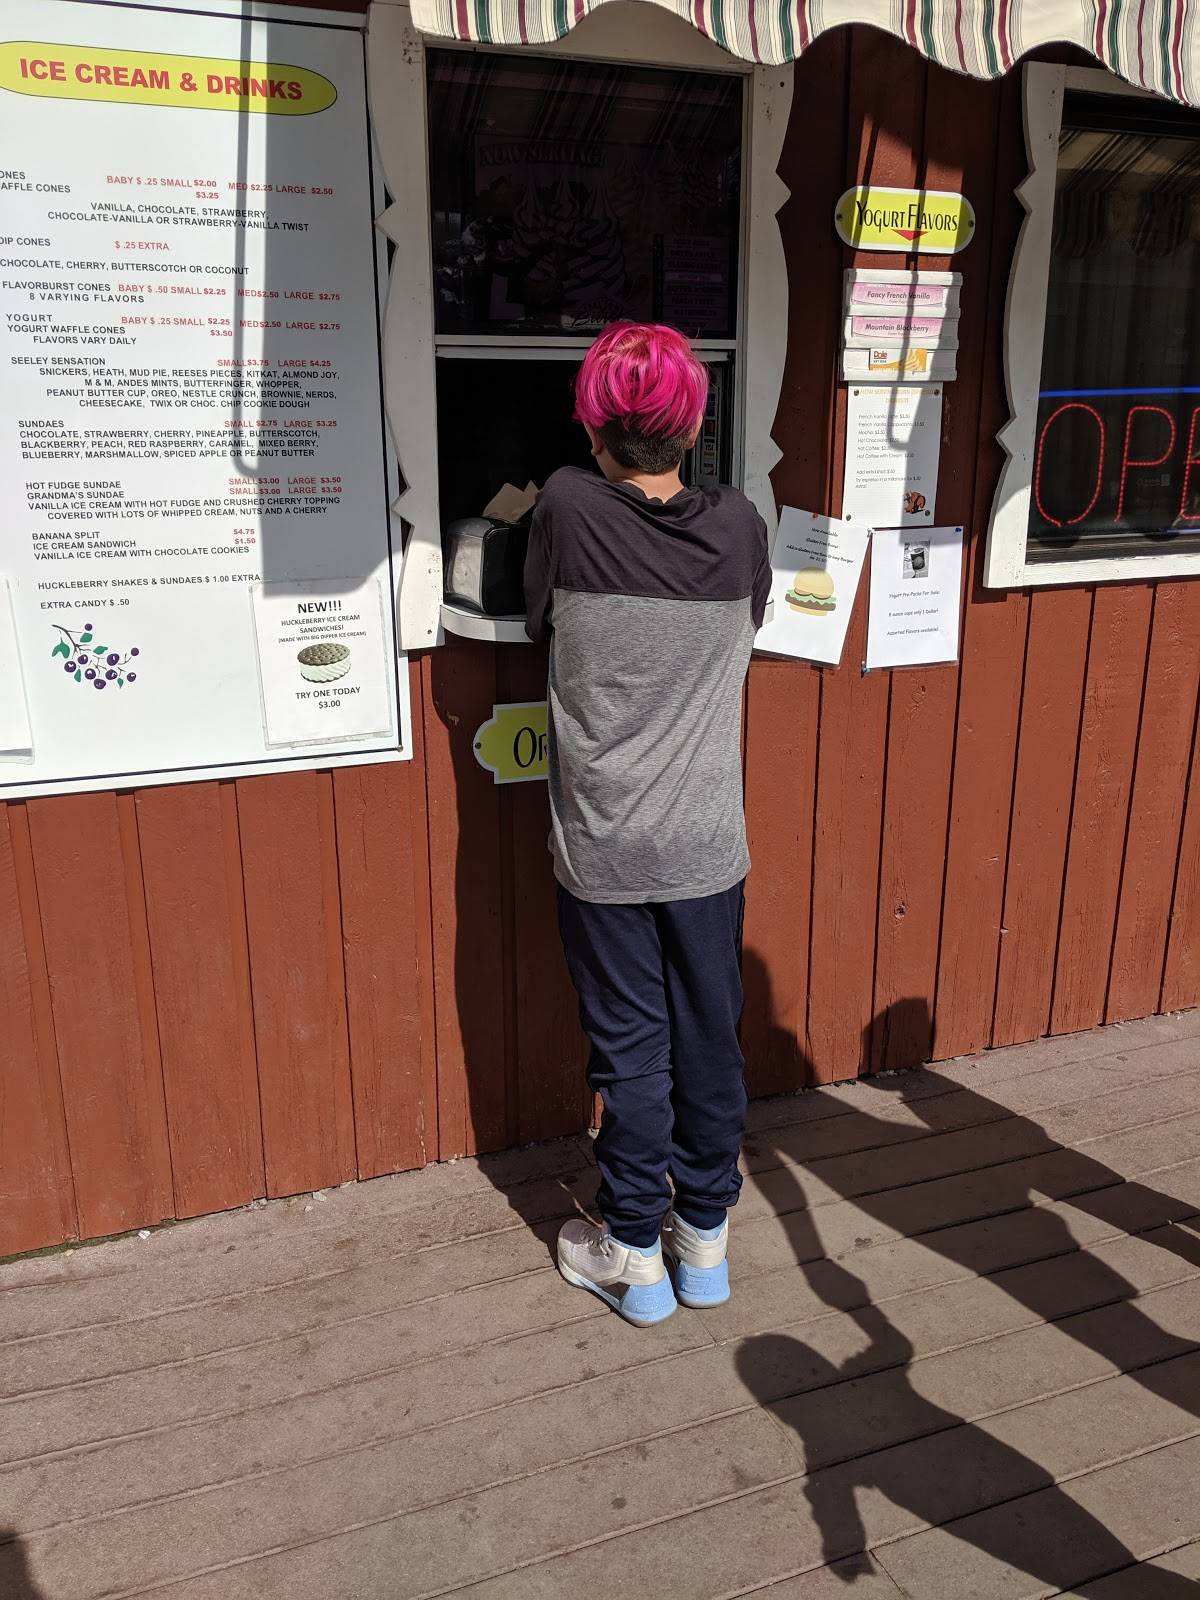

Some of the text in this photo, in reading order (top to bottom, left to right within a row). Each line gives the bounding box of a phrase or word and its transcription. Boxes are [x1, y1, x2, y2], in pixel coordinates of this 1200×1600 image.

[20, 58, 303, 100] ICE CREAM & DRINKS
[107, 175, 133, 184] BABY
[161, 178, 192, 188] SMALL
[194, 179, 217, 188] $2.00
[229, 182, 247, 190] MED
[275, 185, 306, 194] LARGE
[312, 187, 333, 195] $2.50
[36, 184, 71, 193] CONES
[196, 191, 219, 199] $3.25
[48, 212, 309, 231] CHOCOLATE-VANILLA STRAWBERRY-VANILLA TWIST
[16, 237, 51, 246] CONES
[138, 242, 170, 250] EXTRA
[111, 262, 249, 275] BUTTERSCOTCH COCONUT
[3, 281, 74, 291] FLAVORBURST
[78, 283, 111, 292] CONES
[118, 284, 144, 293] BABY
[171, 286, 202, 295] SMALL
[284, 291, 313, 300] LARGE
[319, 293, 340, 301] $2.75
[867, 291, 885, 299] Fancy
[40, 293, 144, 303] VARYING FLAVORS
[6, 314, 52, 322] YOGURT
[122, 316, 147, 324] BABY
[174, 317, 204, 326] SMALL
[286, 322, 315, 330] LARGE
[865, 323, 895, 331] Mountain
[8, 324, 233, 337] YOGURT WAFFLE CONES $3.50
[33, 336, 137, 345] FLAVORS VARY DAILY
[873, 351, 888, 359] Dole
[11, 357, 106, 365] SEELEY SENSATION
[130, 369, 318, 379] MUD REESES ALMOND
[117, 379, 148, 387] ANDES
[47, 389, 217, 398] PEANUT BUTTER NESTLE
[150, 400, 173, 408] TWIX
[174, 400, 188, 408] OR
[221, 400, 241, 408] CHIP
[244, 400, 277, 408] COOKIE
[18, 420, 64, 428] SUNDAES
[259, 440, 286, 448] MIXED
[164, 450, 196, 458] SPICED
[199, 450, 228, 458] APPLE
[230, 450, 242, 458] OR
[281, 449, 315, 457] BUTTER
[25, 476, 341, 490] HOT FUDGE SUNDAE $3.50
[87, 491, 125, 499] SUNDAE
[28, 497, 340, 510] VANILLA CREAM WITH HOT FUDGE AND CRUSHED CHERRY TOPPING
[47, 506, 327, 520] COVERED WITH LOTS WHIPPED NUTS AND CHERRY
[32, 532, 72, 540] BANANA
[51, 542, 85, 550] CREAM
[87, 540, 136, 549] SANDWICH
[34, 546, 250, 560] VANILLA CREAM WITH CHOCOLATE COOKIES
[38, 574, 261, 590] HUCKLEBERRY SHAKES SUNDAES EXTRA
[40, 600, 107, 609] EXTRA CANDY
[298, 600, 342, 614] NEW!!!
[281, 617, 325, 626] HUCKLEBERRY
[338, 614, 360, 622] CREAM
[300, 624, 344, 634] SANDWICHES!
[296, 687, 361, 700] TRY ONE TODAY
[318, 700, 341, 709] $3.00
